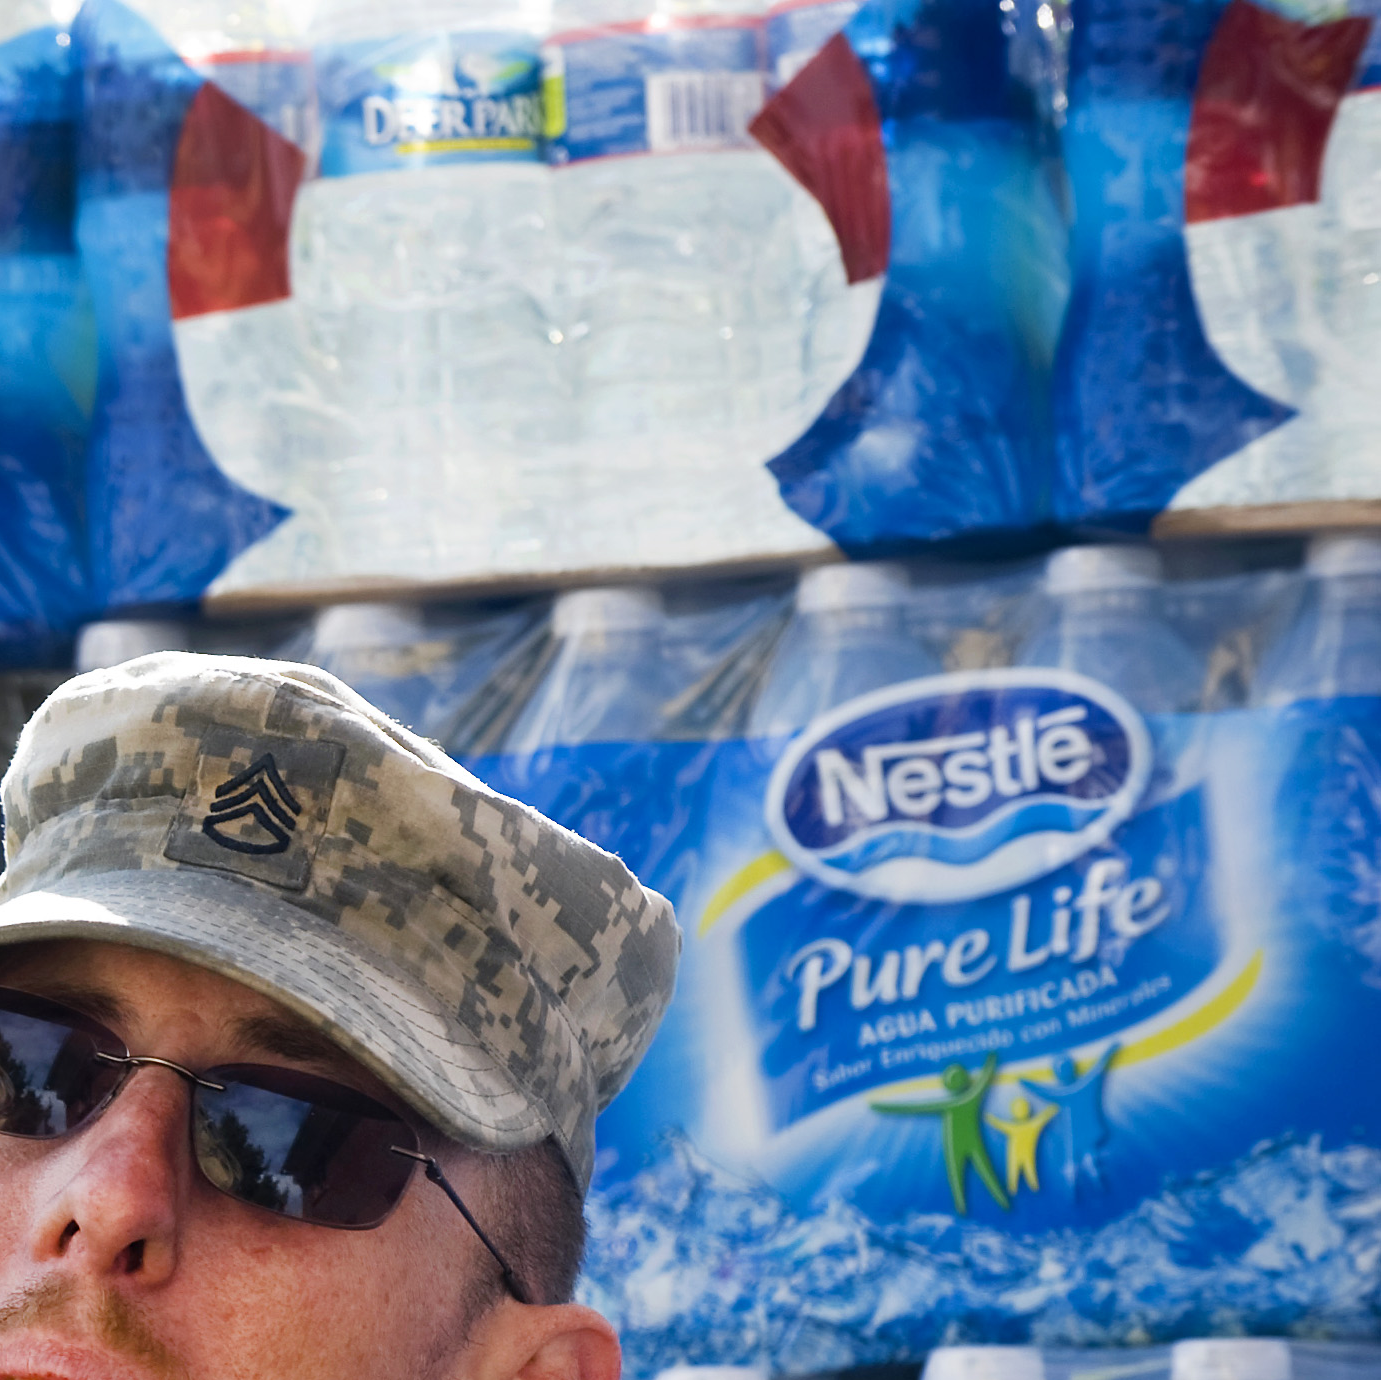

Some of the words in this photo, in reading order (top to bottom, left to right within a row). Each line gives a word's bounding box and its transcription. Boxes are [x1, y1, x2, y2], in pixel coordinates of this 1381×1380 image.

[815, 704, 1093, 827] Nestlé
[785, 937, 997, 1031] Pure
[1007, 857, 1171, 973] Life
[858, 1009, 938, 1049] AGUA
[945, 964, 1119, 1029] PURIFICADA
